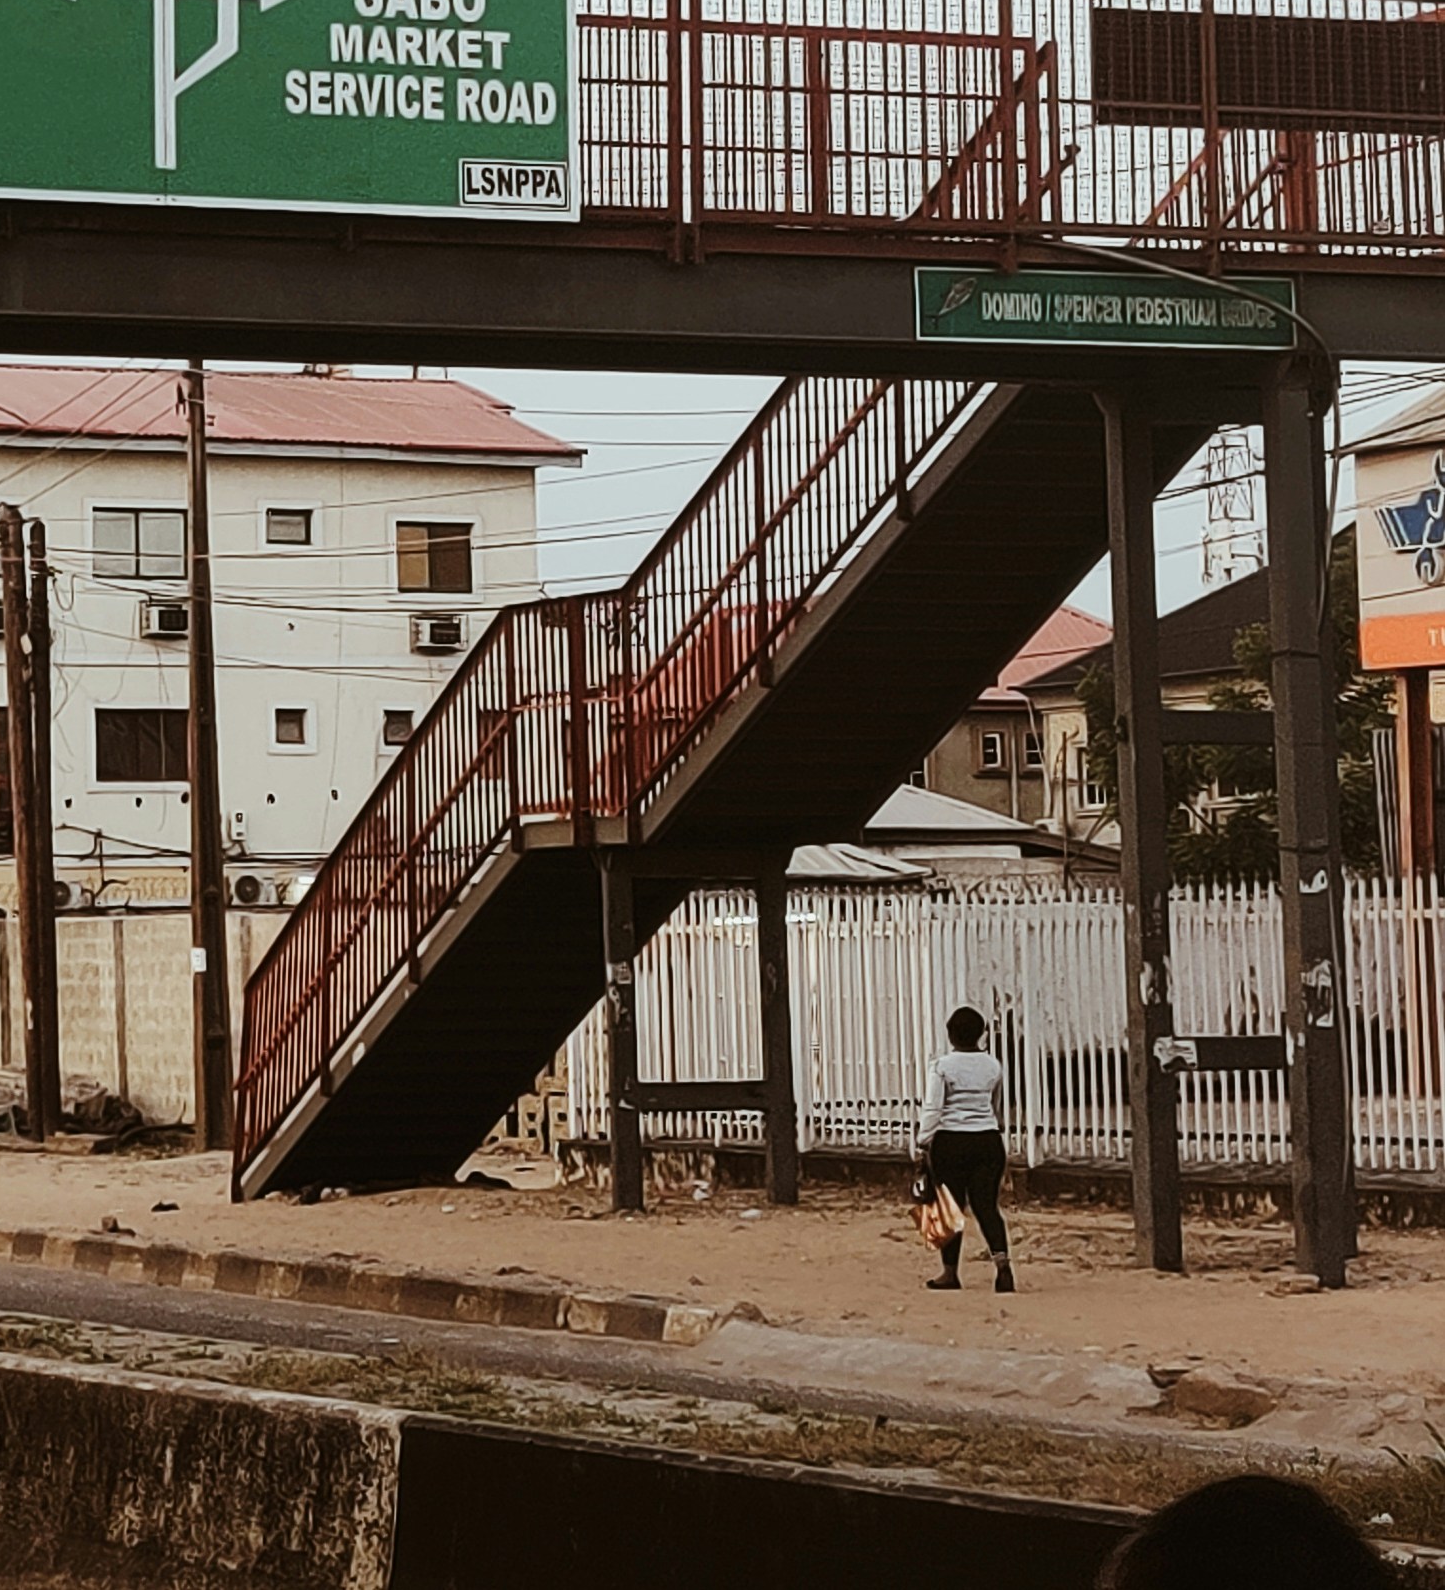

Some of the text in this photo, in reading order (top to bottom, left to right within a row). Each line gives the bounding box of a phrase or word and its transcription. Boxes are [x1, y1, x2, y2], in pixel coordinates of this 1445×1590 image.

[329, 22, 512, 71] MARKET
[284, 68, 558, 126] SERVICE ROAD
[466, 167, 562, 198] LSNPPA
[981, 292, 1042, 322] DOMINO
[1054, 294, 1123, 323] SPENCER
[1126, 296, 1217, 327] PEDESTRIAN
